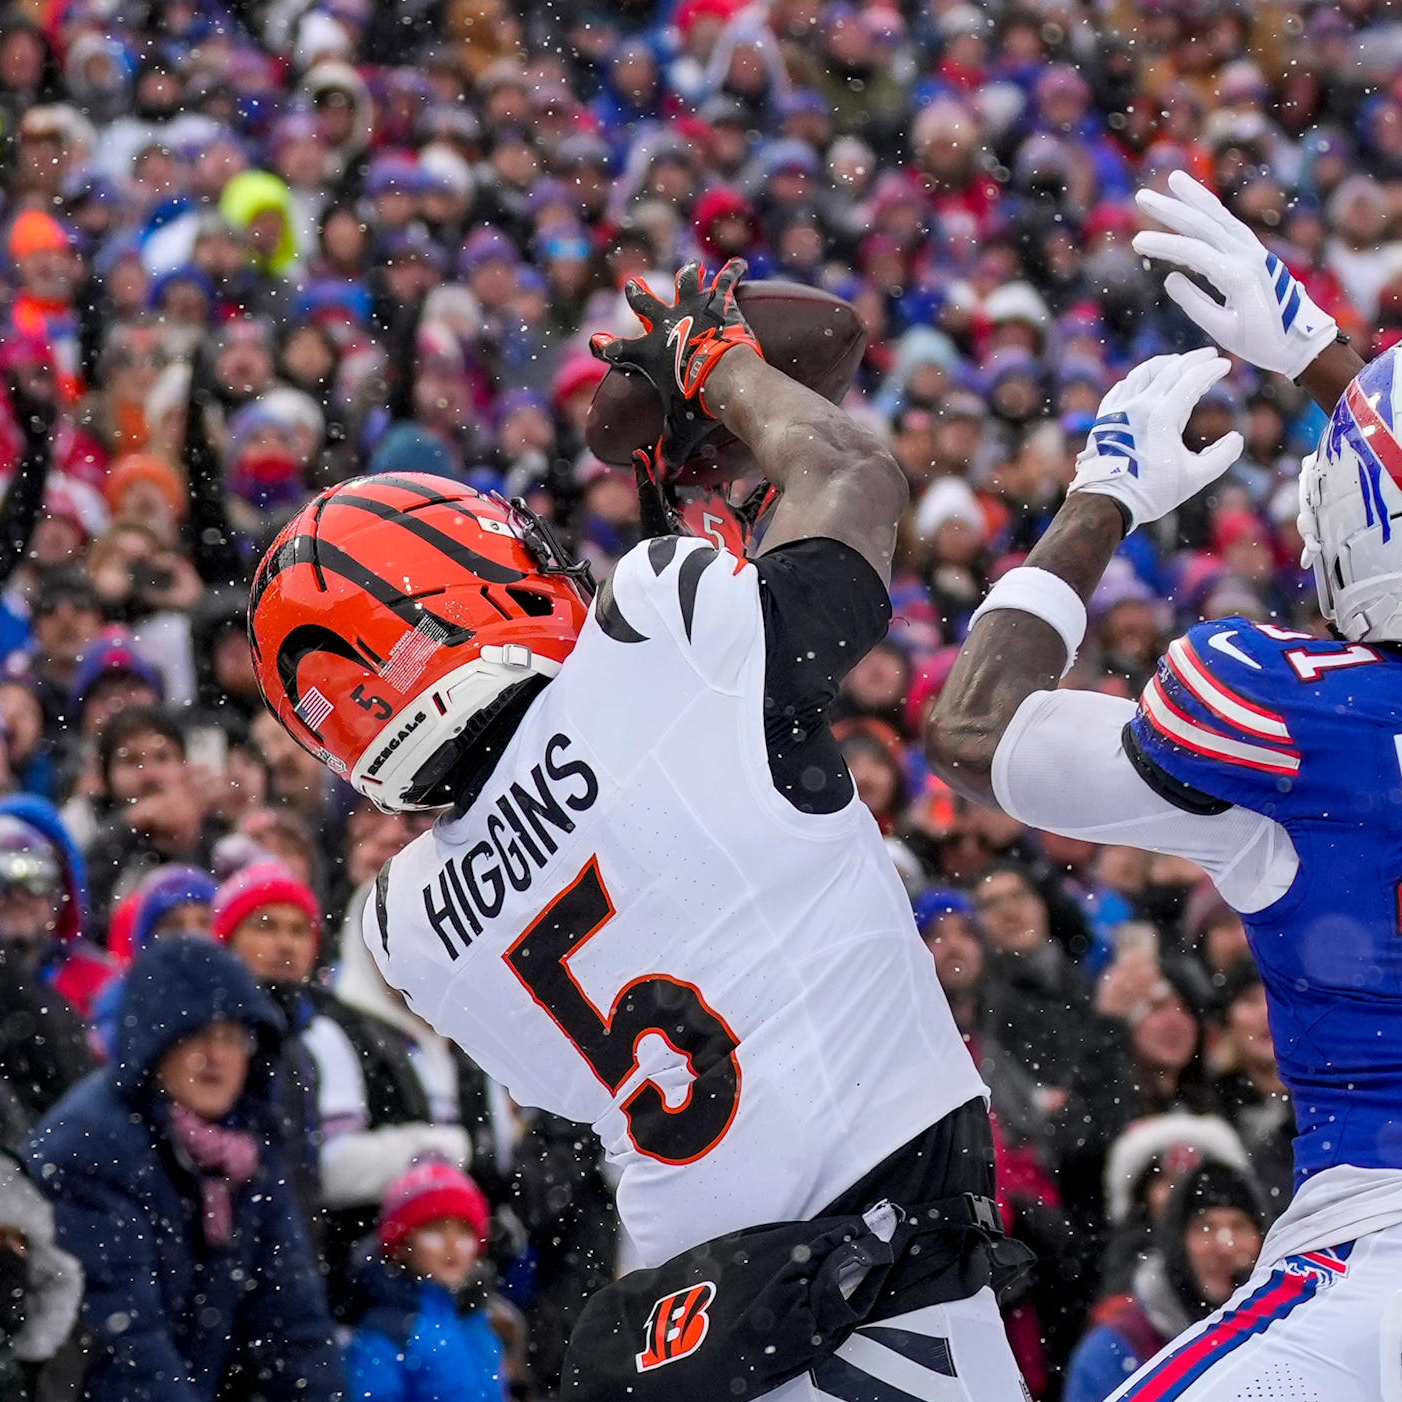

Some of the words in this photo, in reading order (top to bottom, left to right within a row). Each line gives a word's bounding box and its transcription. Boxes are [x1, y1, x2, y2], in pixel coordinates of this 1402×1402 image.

[702, 511, 725, 550] 5
[350, 683, 394, 721] 5
[367, 710, 428, 776] BENGALS
[422, 733, 599, 961] HIGGINS
[500, 852, 742, 1166] 5
